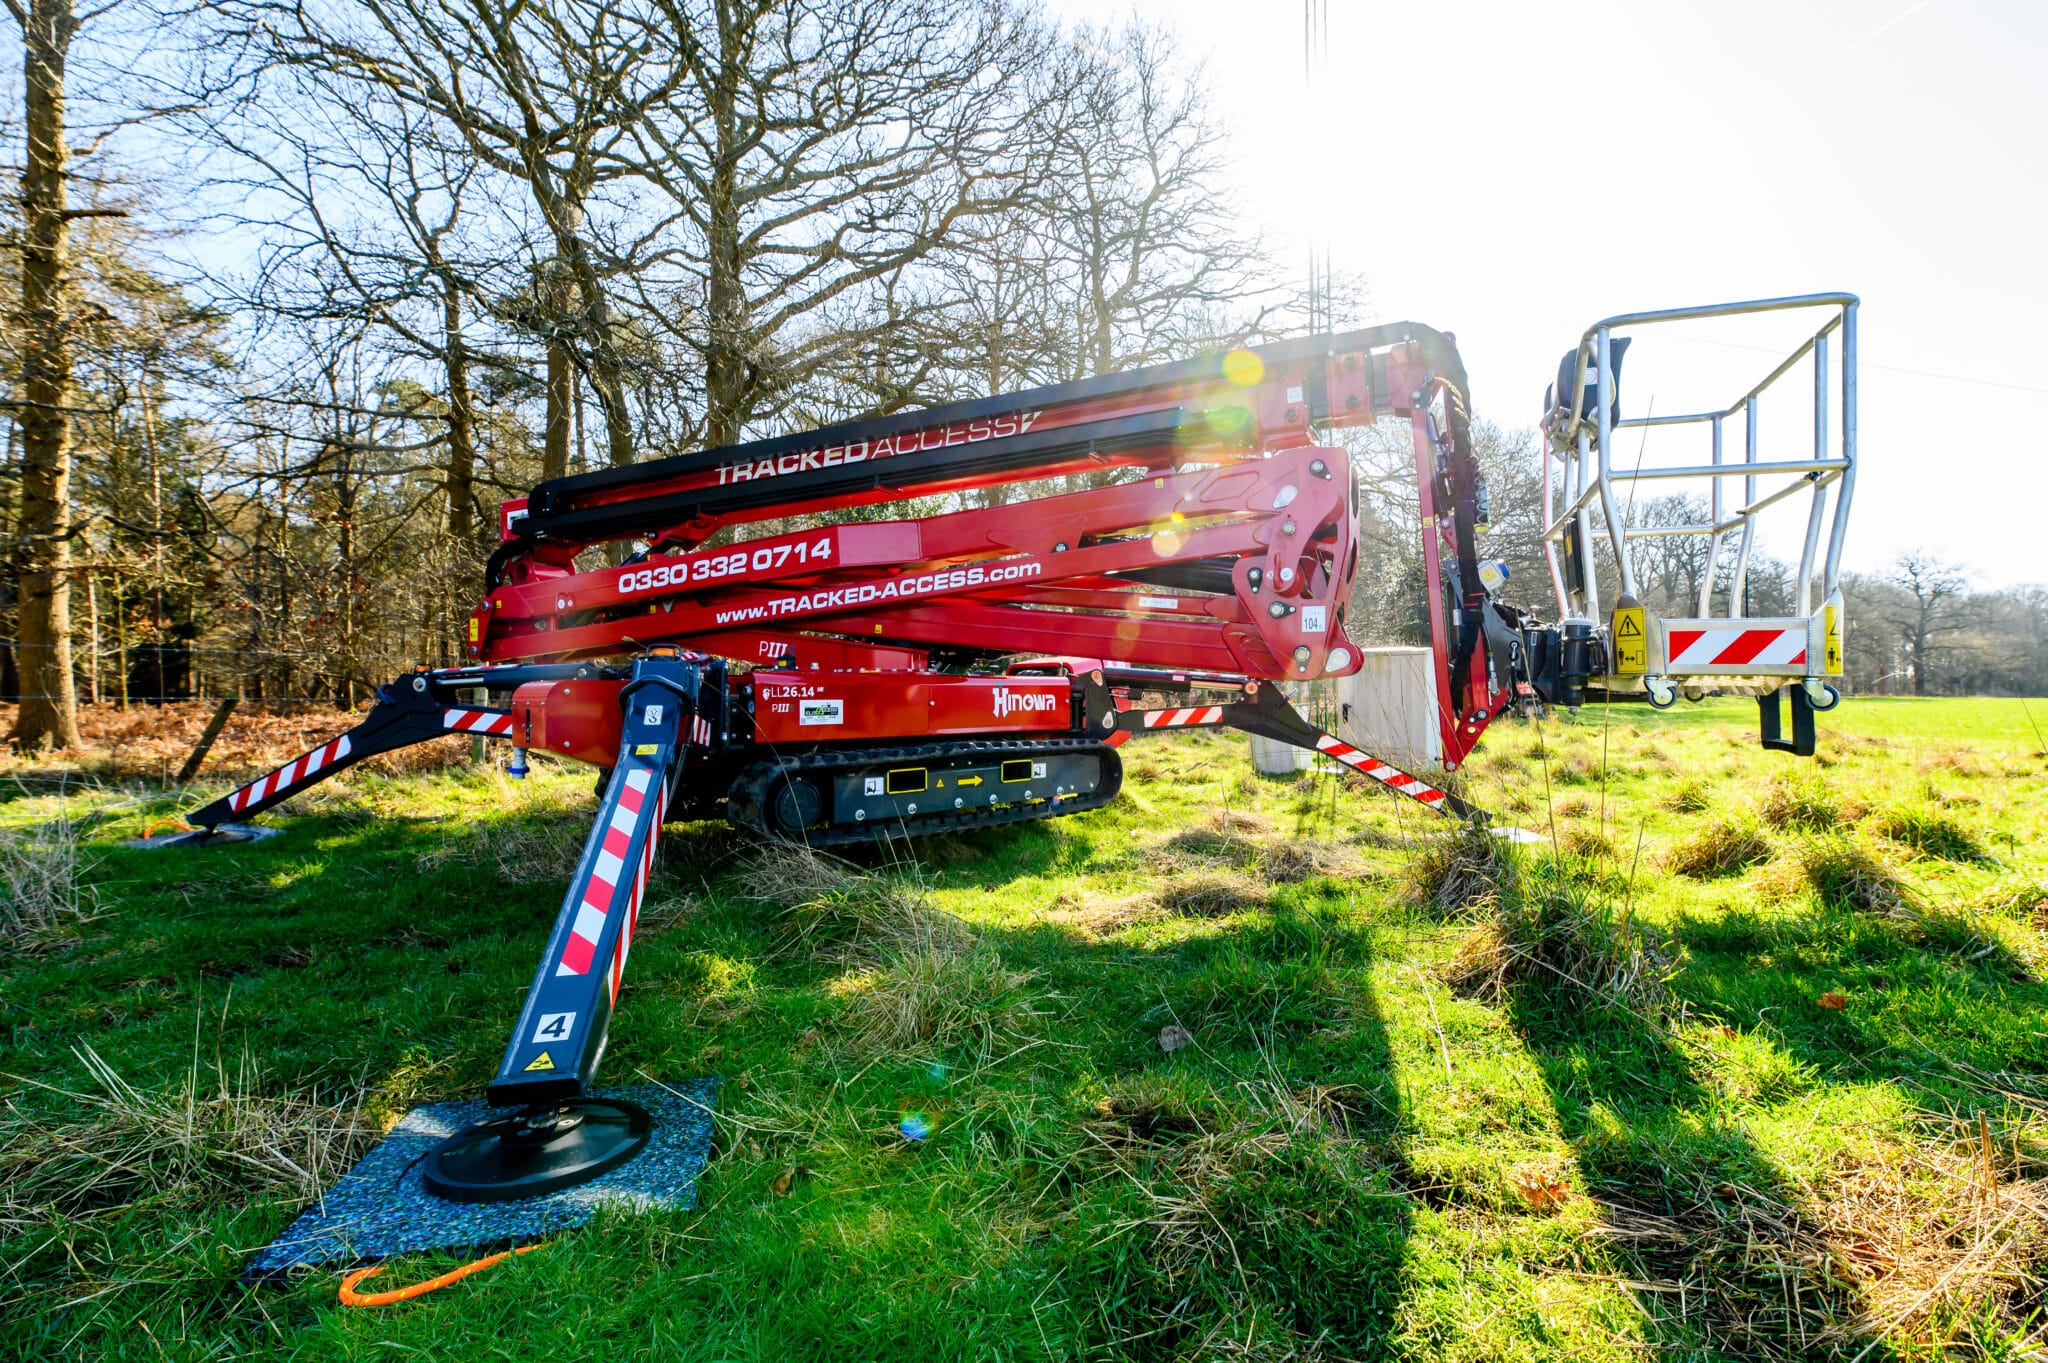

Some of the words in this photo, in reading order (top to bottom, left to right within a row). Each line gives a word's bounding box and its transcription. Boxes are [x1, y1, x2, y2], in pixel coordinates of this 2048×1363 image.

[618, 563, 688, 594] 0330
[692, 553, 748, 581] 332
[752, 537, 832, 571] 0714
[715, 562, 1042, 624] www.TRACKED-ACCESS.com
[1304, 617, 1318, 630] 104
[540, 1015, 566, 1038] 4
